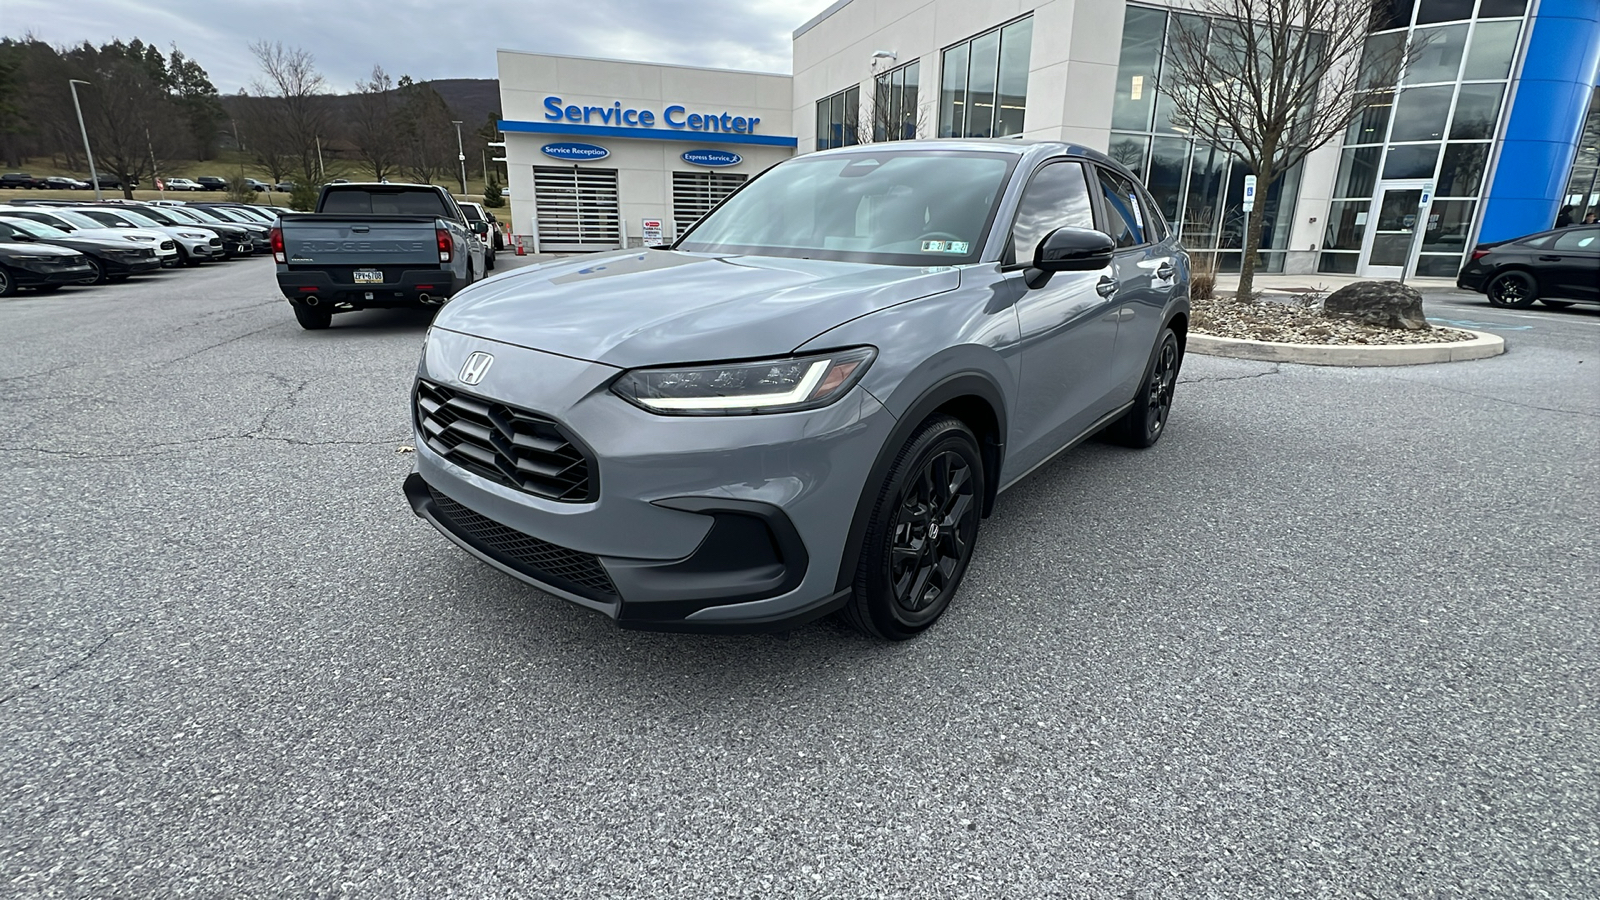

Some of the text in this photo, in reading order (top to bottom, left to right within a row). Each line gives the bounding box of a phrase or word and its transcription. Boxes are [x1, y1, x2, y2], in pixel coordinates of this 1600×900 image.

[543, 96, 761, 134] Service Center
[545, 146, 606, 156] Service Reception
[684, 153, 730, 162] Express Service
[300, 242, 424, 252] RIDGELINE
